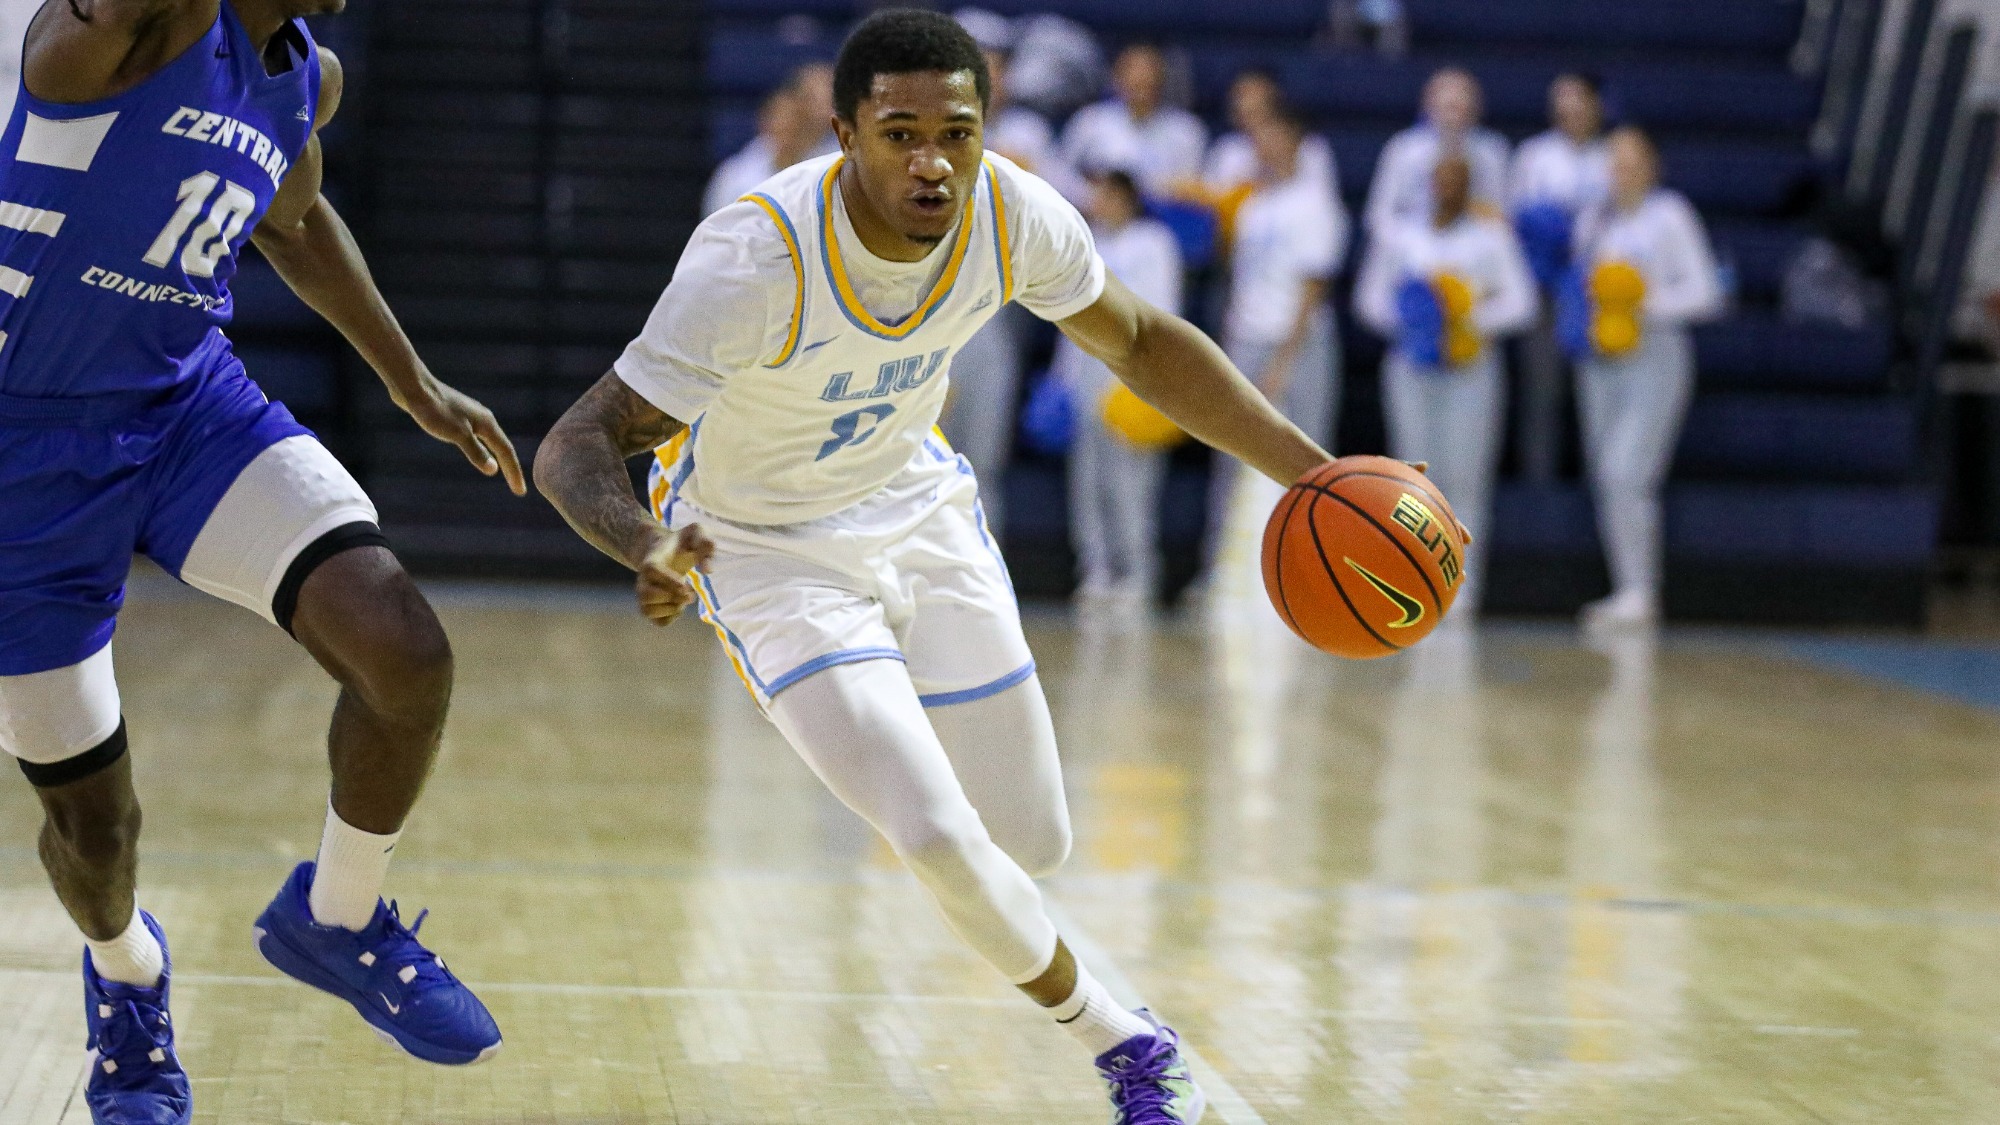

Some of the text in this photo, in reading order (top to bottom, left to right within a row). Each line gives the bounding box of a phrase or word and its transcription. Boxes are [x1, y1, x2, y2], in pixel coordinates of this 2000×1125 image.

[162, 106, 287, 192] CENTRAL
[142, 170, 255, 277] 10
[818, 346, 949, 402] LIU
[1390, 495, 1459, 590] ELITE
